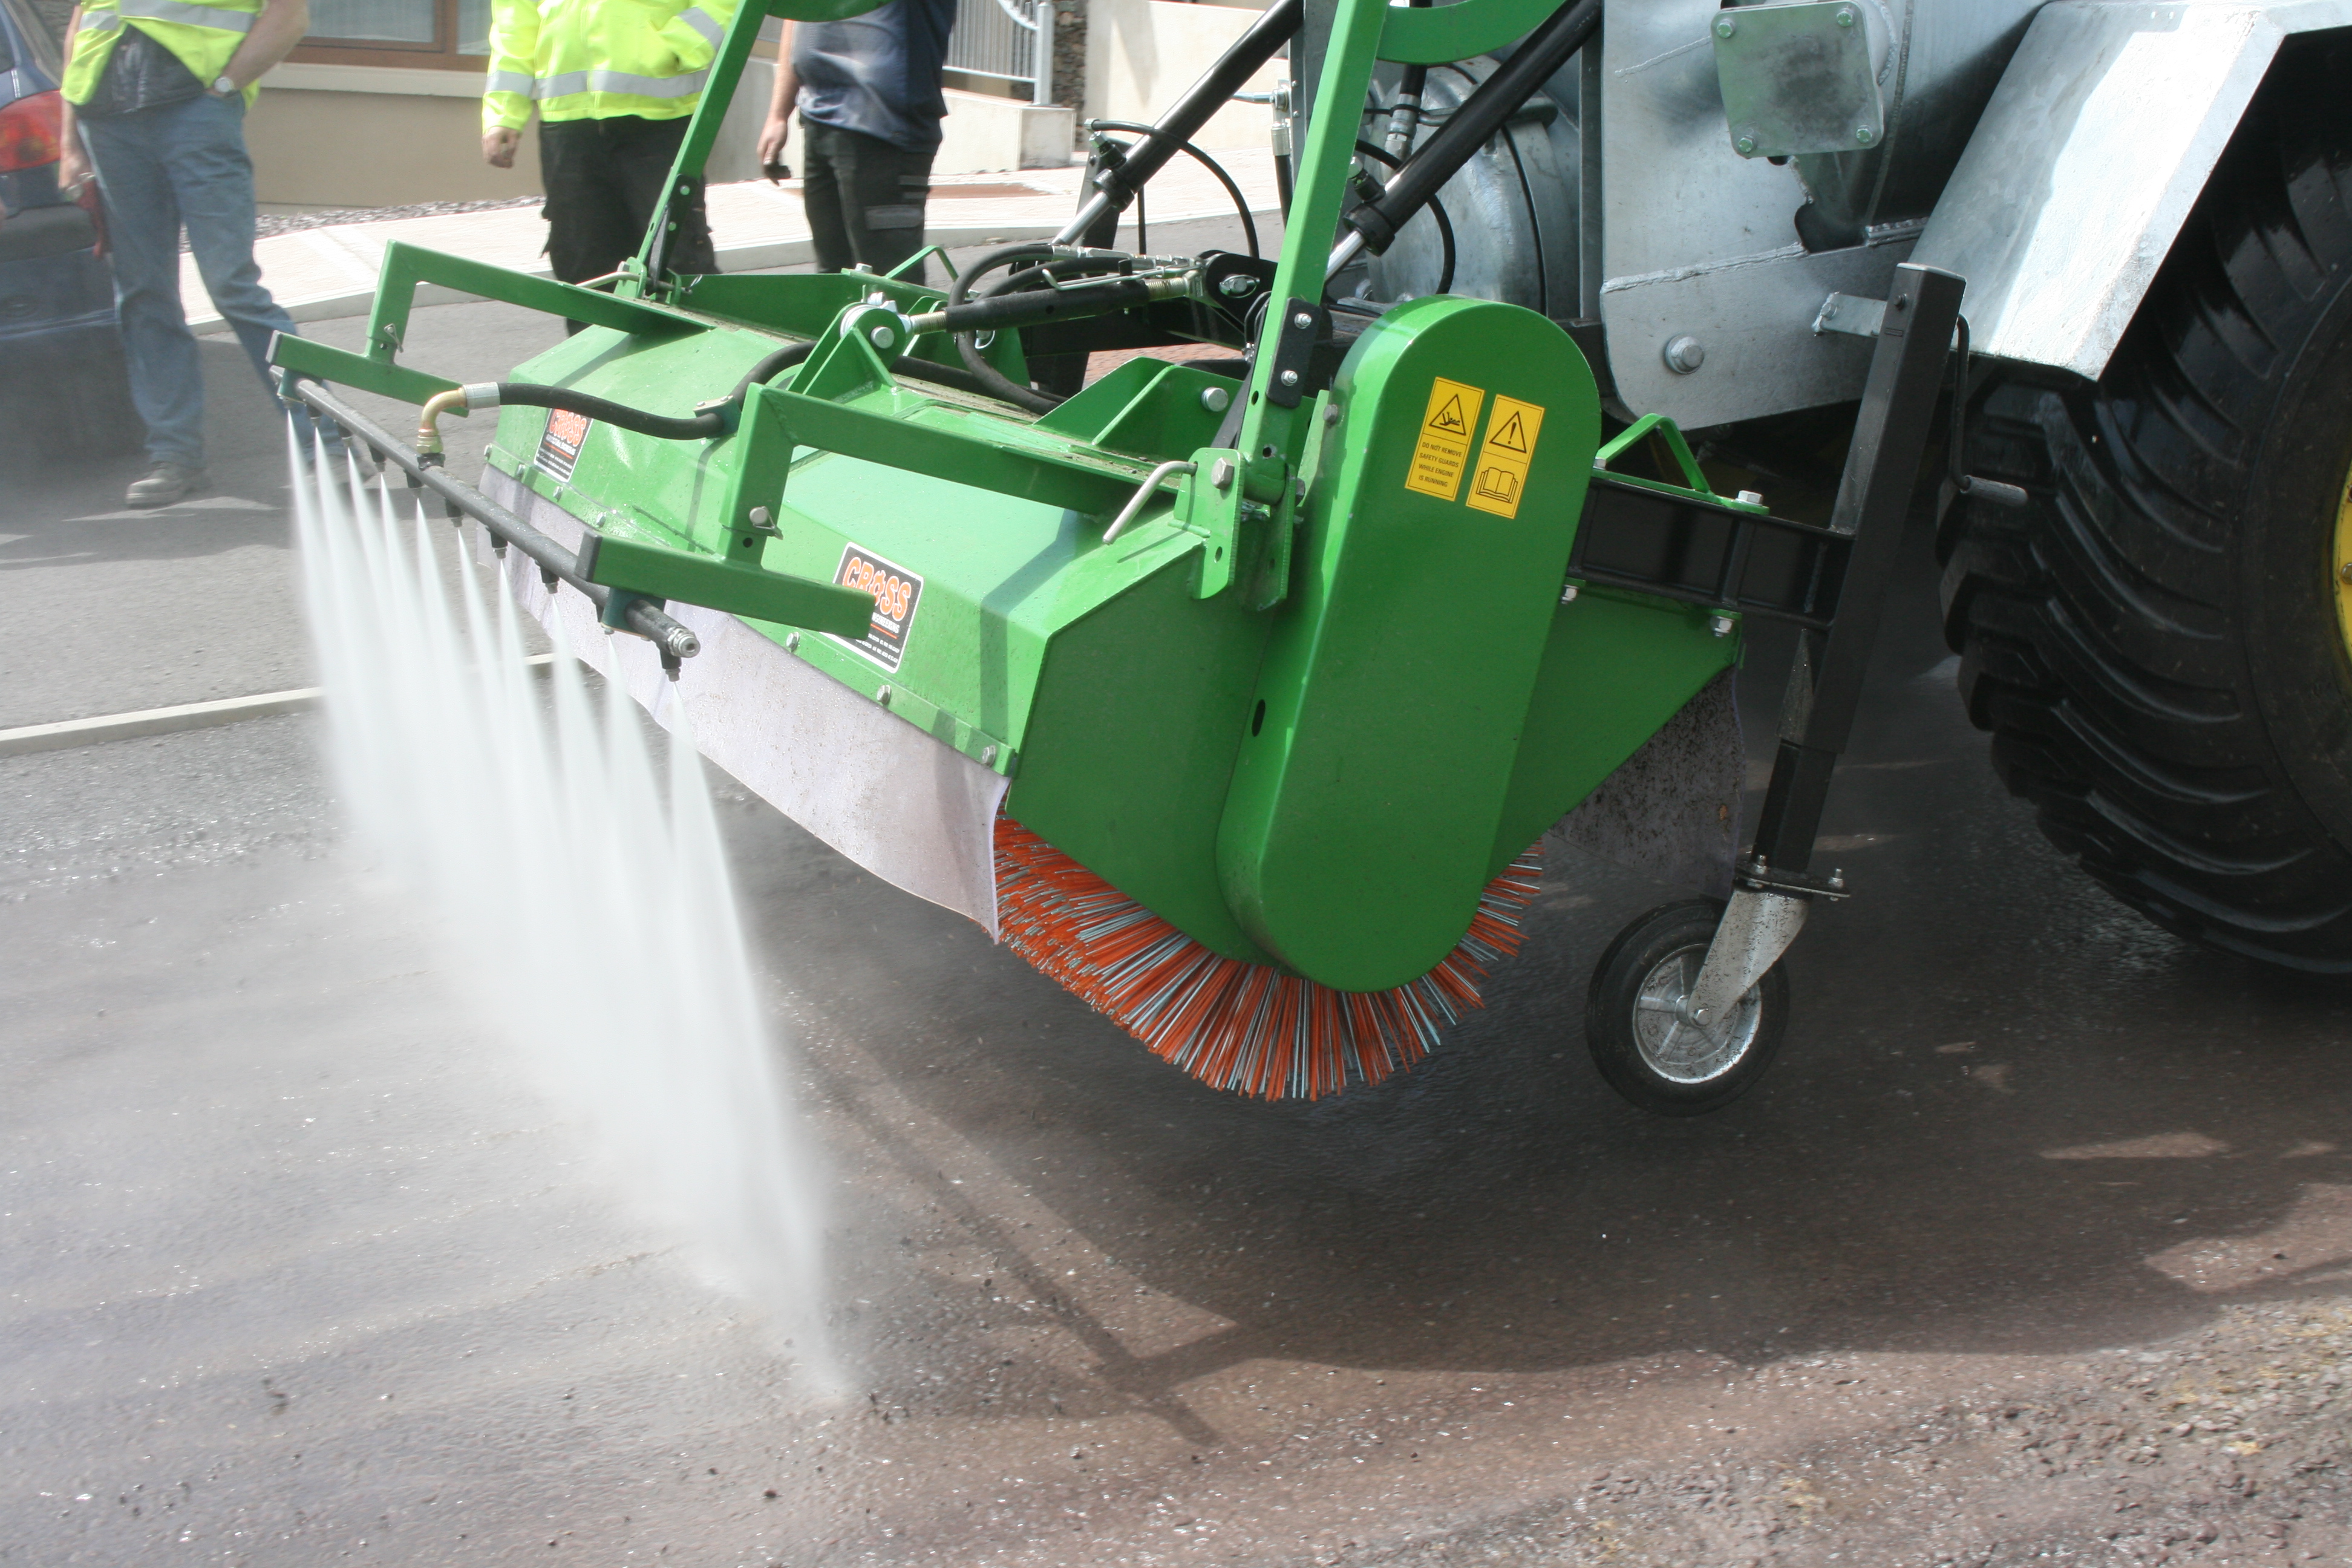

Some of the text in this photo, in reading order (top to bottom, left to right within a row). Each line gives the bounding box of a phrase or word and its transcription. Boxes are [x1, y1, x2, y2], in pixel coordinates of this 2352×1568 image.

[550, 409, 587, 447] CROSS
[1442, 447, 1462, 457] REMOVE
[1419, 452, 1459, 468] SAFETY GUARDS
[1419, 463, 1454, 478] WHILE ENGINE
[1424, 476, 1448, 487] RUNNING
[842, 557, 912, 622] CROSS
